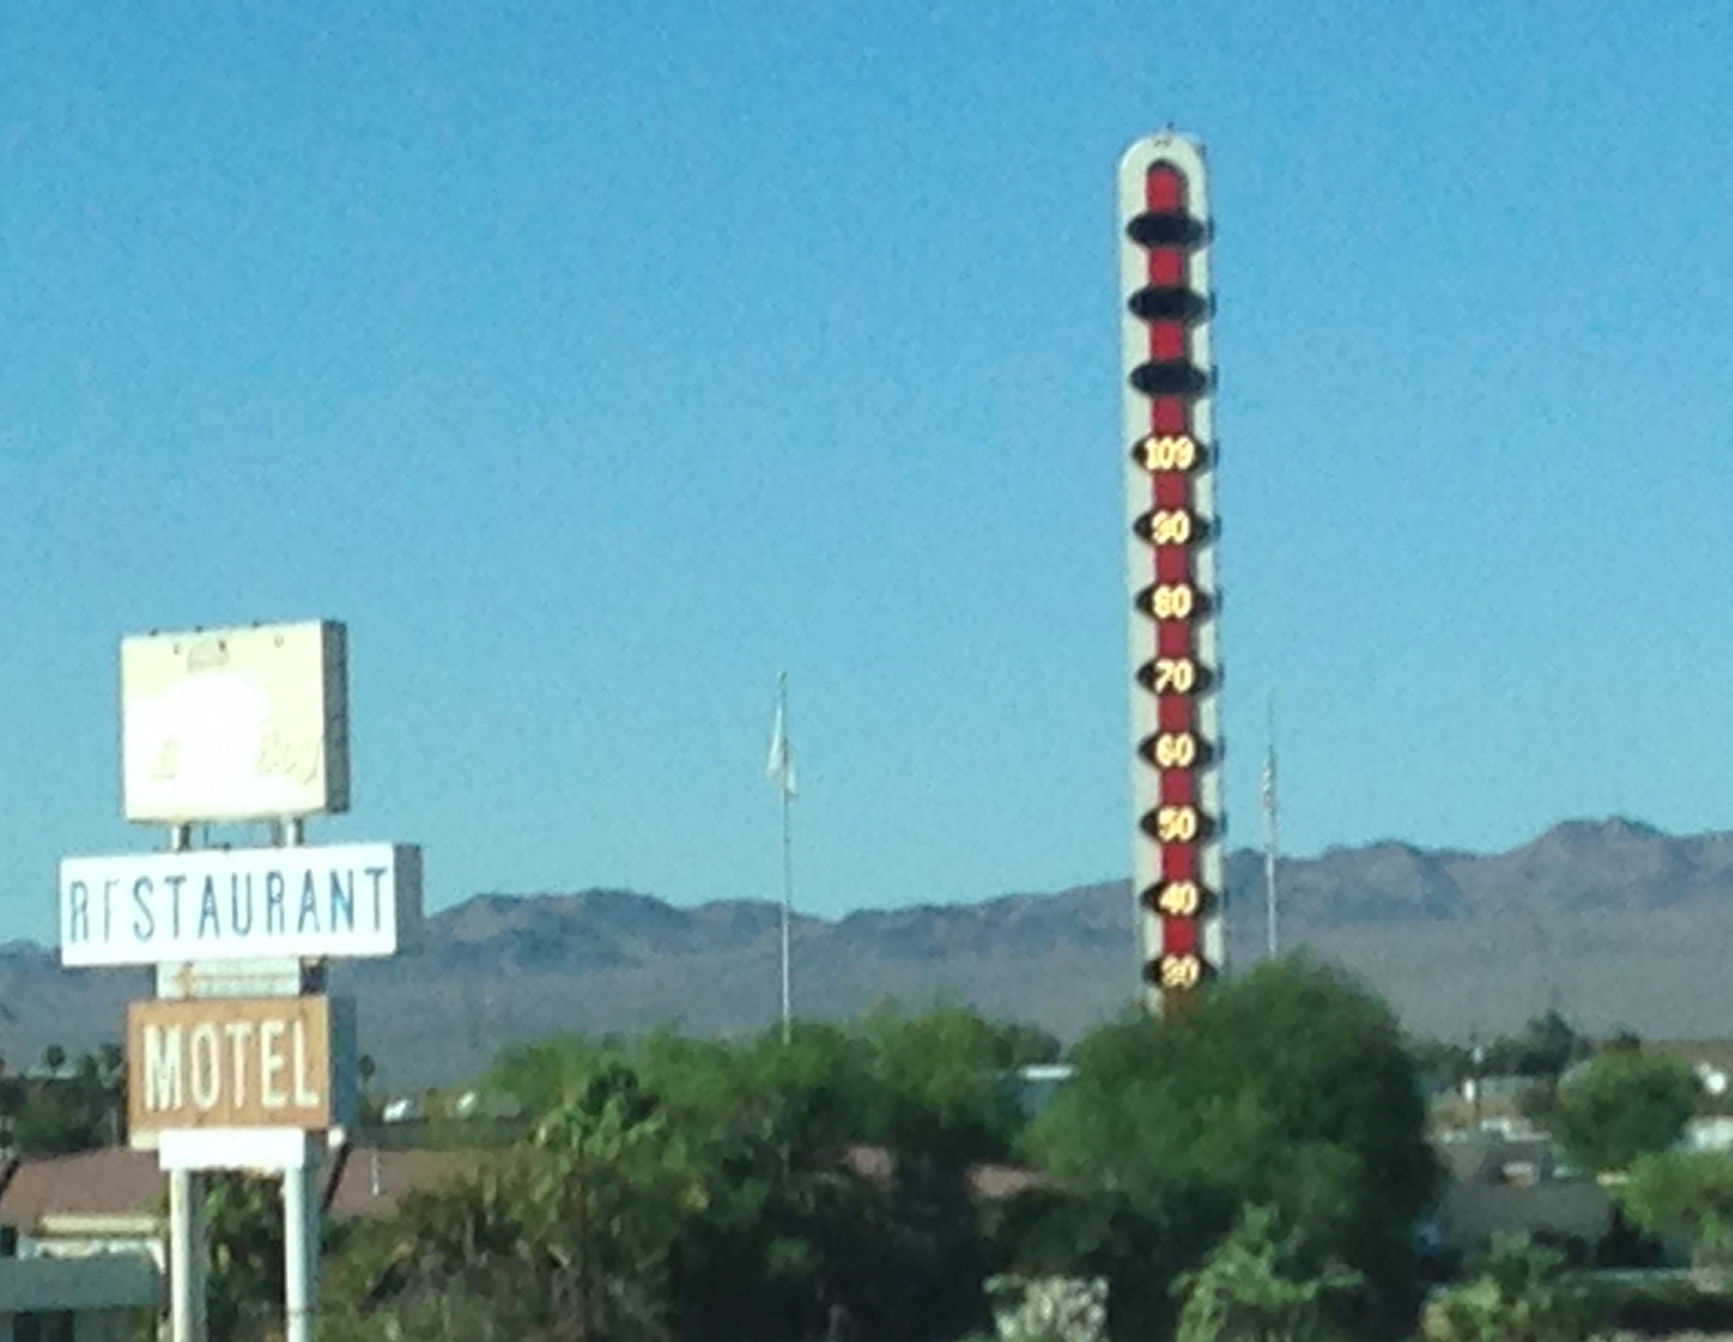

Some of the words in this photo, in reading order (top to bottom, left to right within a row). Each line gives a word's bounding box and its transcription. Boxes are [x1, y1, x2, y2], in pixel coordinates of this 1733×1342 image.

[1152, 583, 1192, 619] 80
[1154, 657, 1195, 694] 70
[1155, 732, 1195, 767] 60
[1157, 805, 1198, 841] 50
[1158, 881, 1199, 916] 40
[143, 1018, 319, 1113] MOTEL
